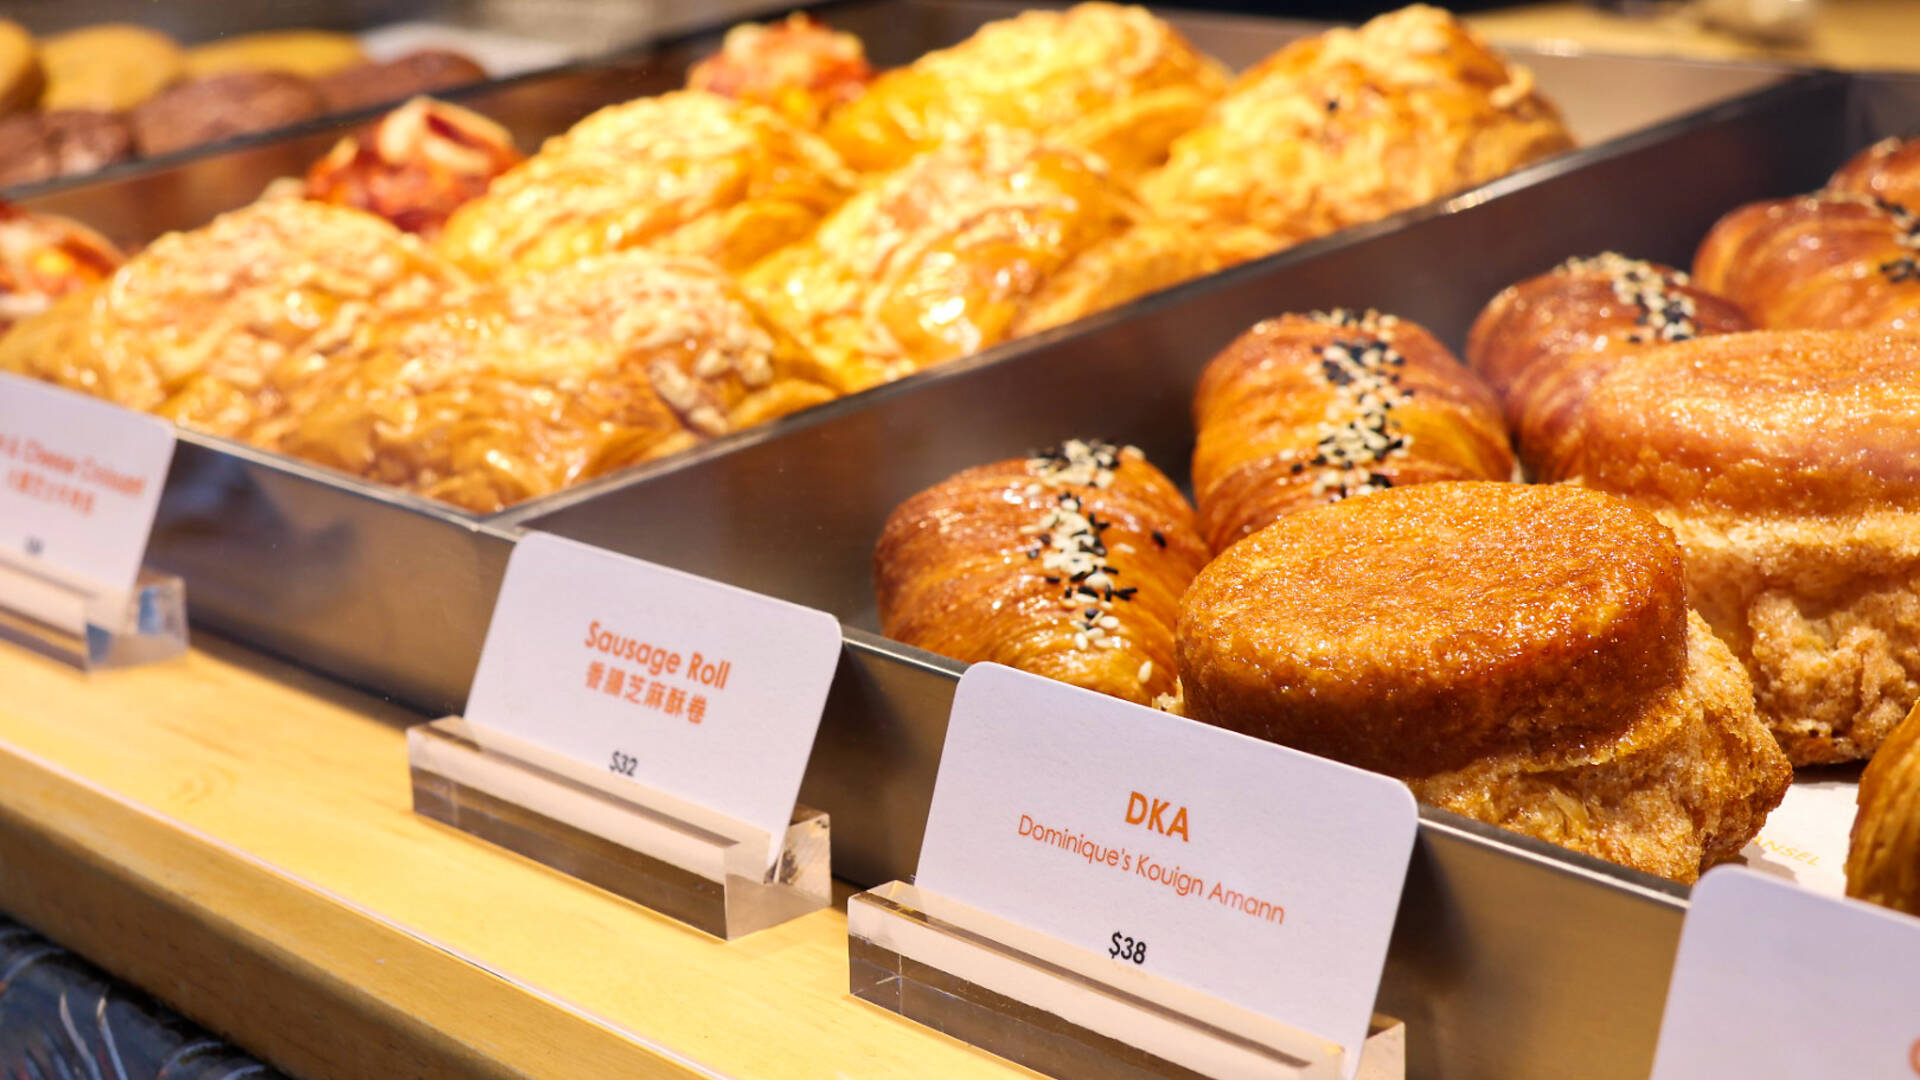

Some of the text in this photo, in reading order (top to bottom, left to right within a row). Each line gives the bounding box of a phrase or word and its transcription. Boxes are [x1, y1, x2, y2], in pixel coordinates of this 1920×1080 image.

[585, 620, 731, 690] Sausage Roll
[609, 750, 638, 777] $32
[1125, 790, 1190, 842] DKA
[1018, 814, 1285, 925] Dominique's Kouign Amann
[1108, 930, 1147, 965] $38
